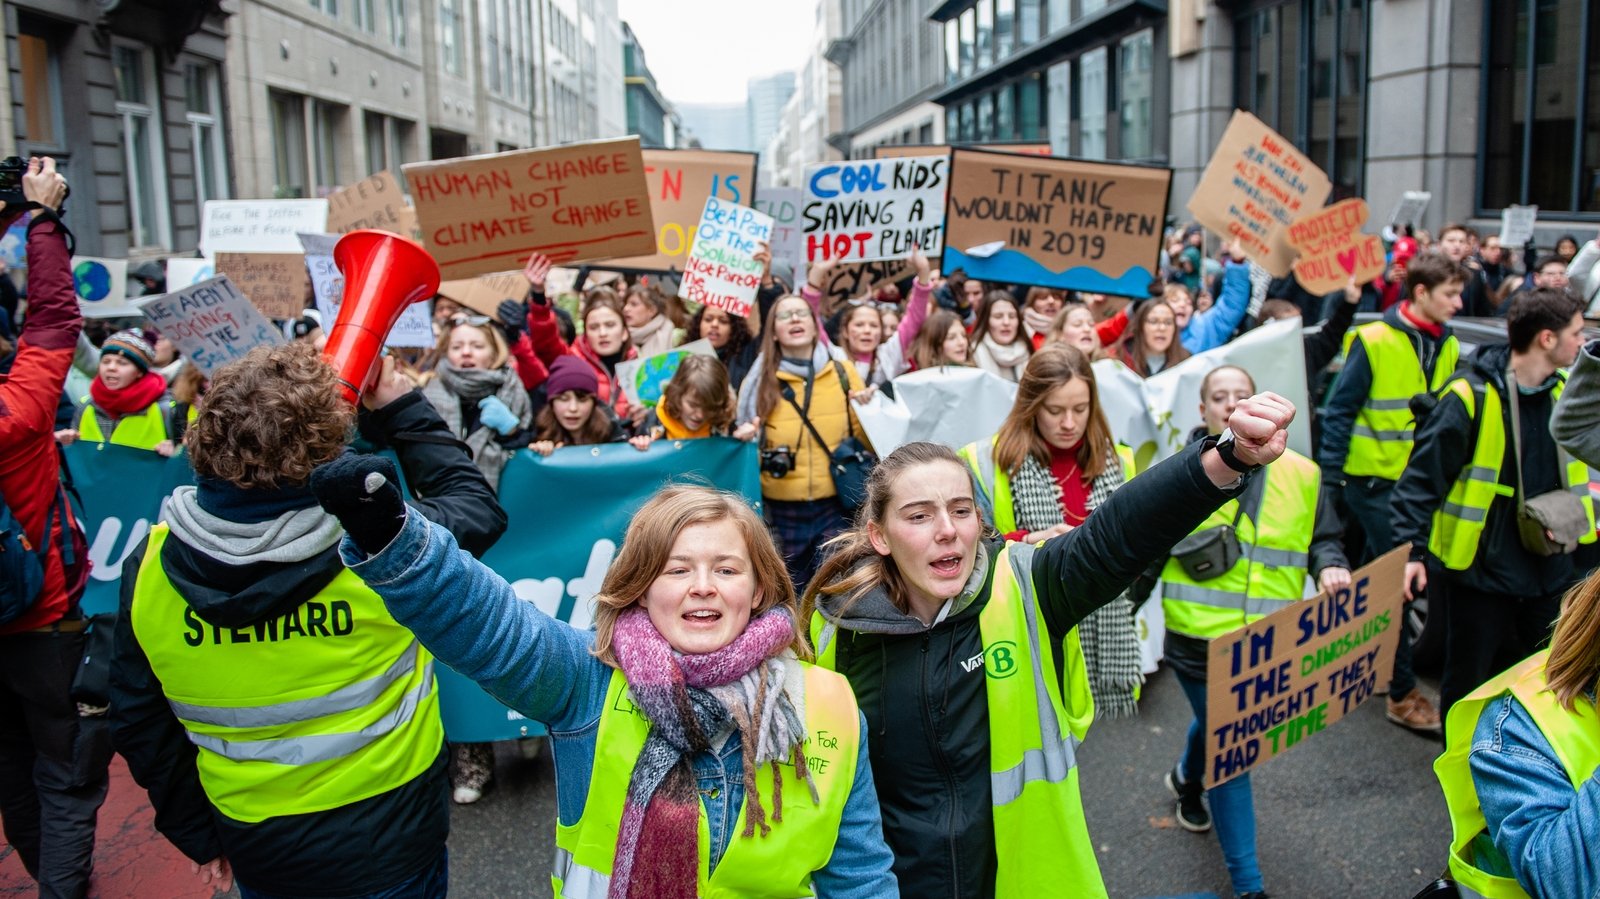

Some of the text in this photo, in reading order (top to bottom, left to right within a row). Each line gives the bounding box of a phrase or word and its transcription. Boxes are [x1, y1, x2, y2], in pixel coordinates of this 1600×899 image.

[415, 153, 631, 202] HUMAN CHANGE
[711, 173, 741, 204] IS
[809, 163, 887, 198] COOL
[991, 168, 1117, 211] TITANIC
[510, 186, 566, 213] NOT
[551, 198, 642, 228] CHANGE
[908, 198, 924, 223] A
[951, 196, 1157, 237] WOULDNT HAPPEN
[739, 210, 768, 240] Part
[806, 225, 942, 263] HOT PLANET
[1009, 227, 1106, 260] IN 2019
[205, 325, 240, 347] THE
[1231, 576, 1370, 678] I'M SURE
[960, 651, 986, 673] VAN
[1231, 608, 1392, 713] THE DINOSAURS
[1213, 643, 1382, 750] THOUGHT THEY
[1213, 670, 1378, 784] HAD TIME TOO
